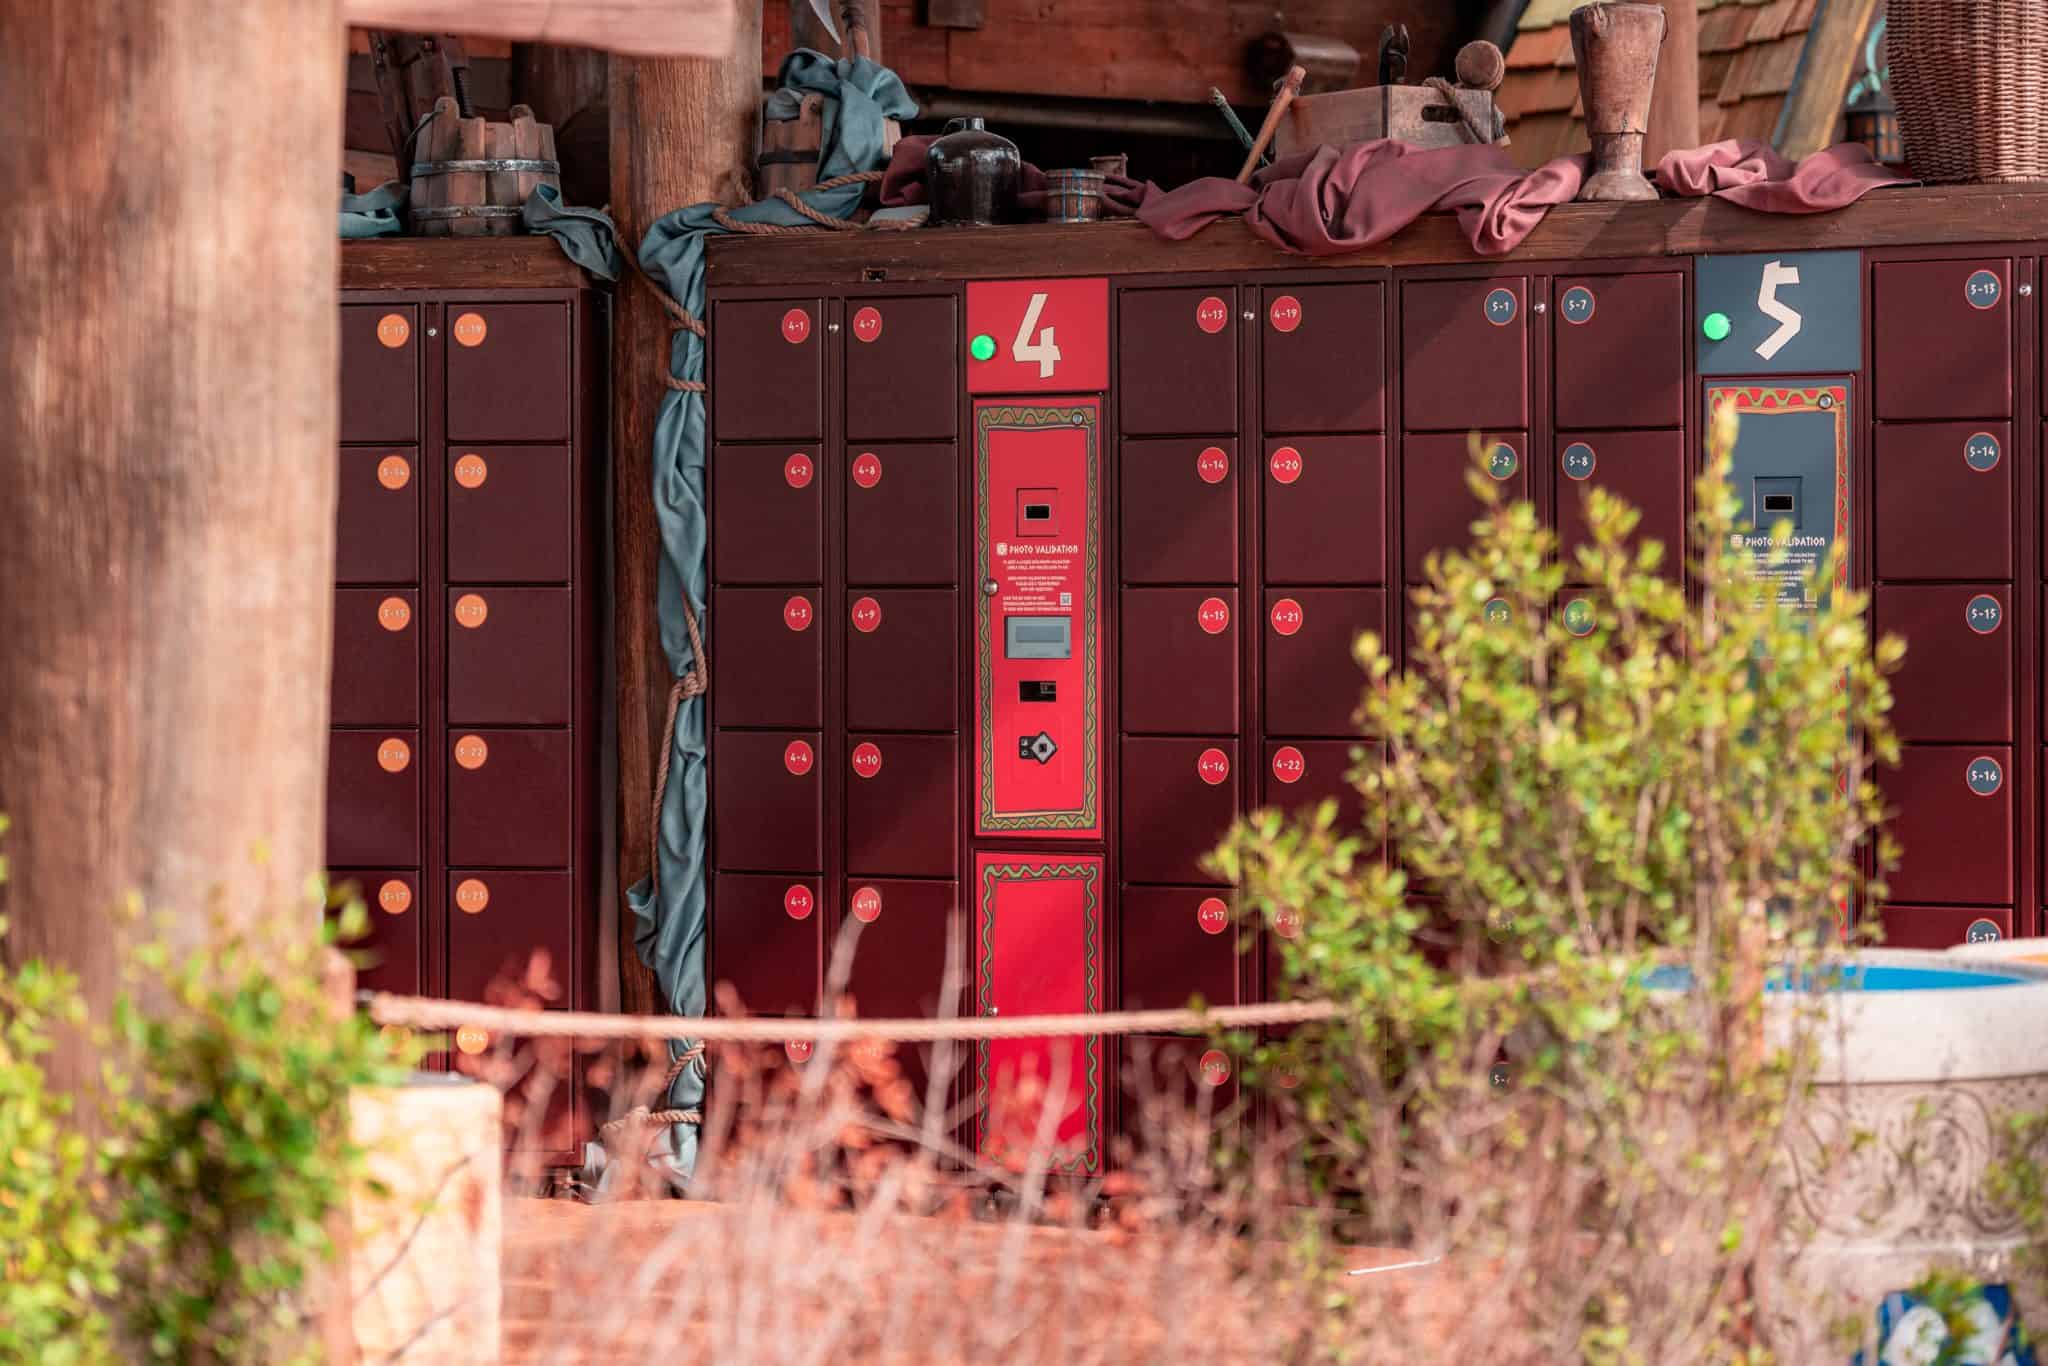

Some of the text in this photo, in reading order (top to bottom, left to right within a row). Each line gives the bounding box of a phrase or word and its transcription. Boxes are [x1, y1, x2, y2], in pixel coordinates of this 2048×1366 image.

[1970, 283, 1995, 295] 5-13
[1492, 301, 1510, 312] 5-1
[1568, 299, 1587, 311] 5-7
[1755, 260, 1801, 360] 5
[1201, 310, 1223, 320] 4-13
[1274, 308, 1297, 319] 4-19
[788, 321, 804, 331] 4-1
[859, 319, 875, 328] 4-7
[1012, 293, 1061, 378] 4
[1970, 446, 1994, 457] 5-14
[1201, 460, 1224, 470] 4-14
[1274, 459, 1298, 470] 4-20
[1569, 455, 1588, 467] 5-8
[791, 466, 807, 475] 4-2
[858, 466, 875, 475] 4-8
[1745, 536, 1773, 547] PHOTO
[1009, 544, 1078, 554] PHOTO VALIDATION
[858, 609, 875, 619] 4-9
[1202, 610, 1225, 620] 4-15
[1276, 611, 1298, 622] 4-21
[1971, 608, 1996, 620] 5-15
[790, 753, 807, 762] 4-4
[856, 754, 878, 764] 4-10
[1202, 760, 1224, 772] 4-16
[1277, 759, 1300, 770] 4-22
[1972, 770, 1997, 782] 5-16
[790, 896, 807, 906] 4-5
[857, 899, 877, 909] 4-11
[1202, 911, 1224, 921] 4-17
